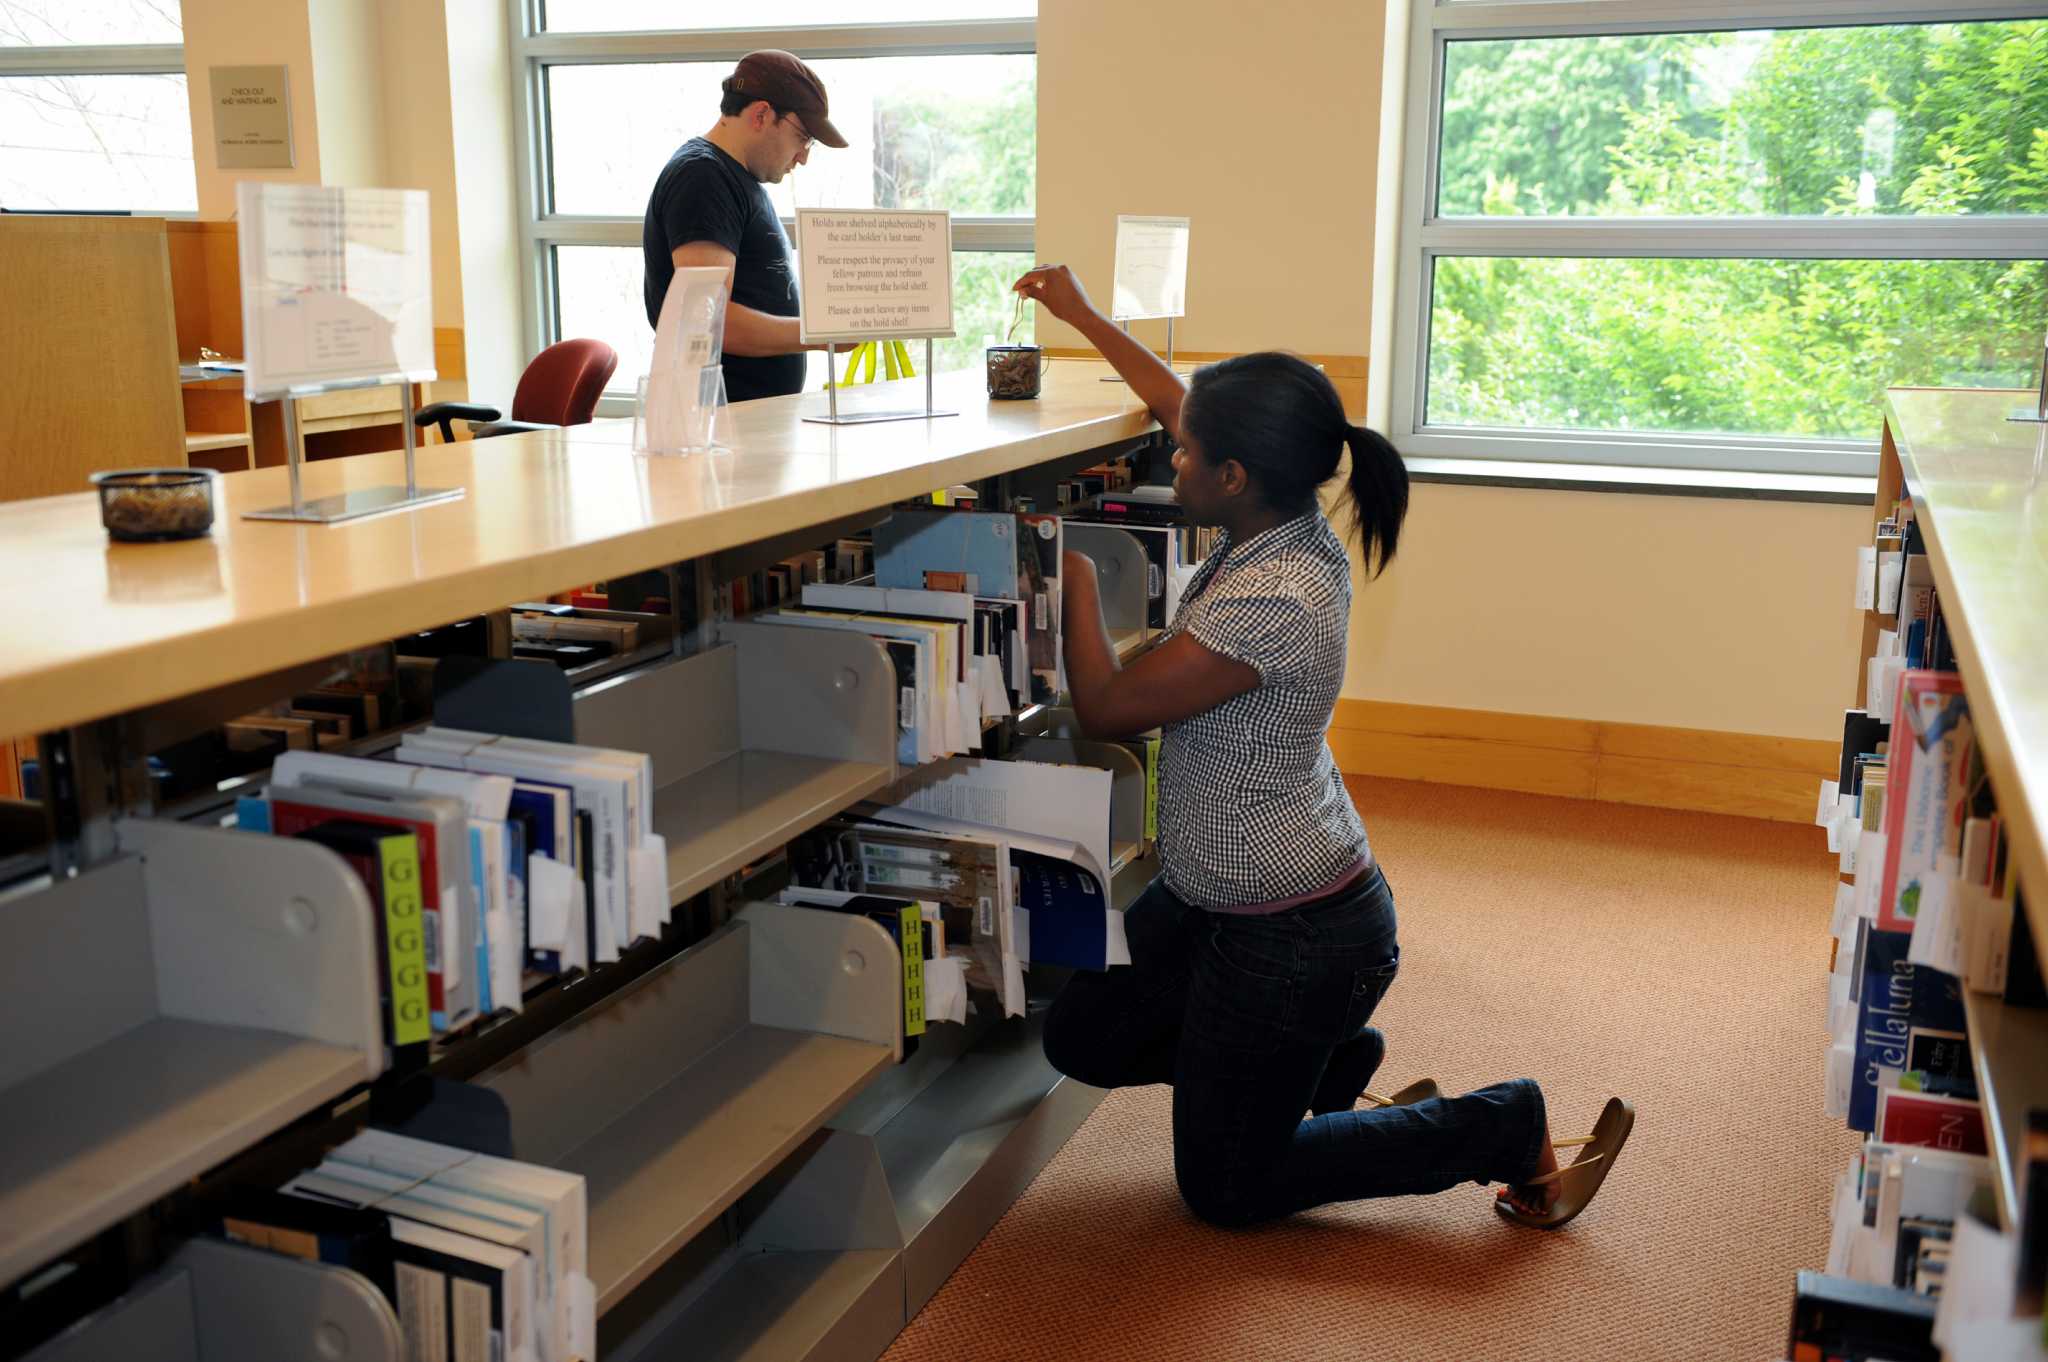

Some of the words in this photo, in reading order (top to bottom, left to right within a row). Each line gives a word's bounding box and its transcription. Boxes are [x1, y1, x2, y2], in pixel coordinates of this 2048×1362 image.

[811, 217, 834, 228] Holds
[836, 220, 848, 228] are
[849, 217, 877, 228] shelved
[878, 217, 927, 231] alphabetically
[928, 218, 937, 231] by
[827, 232, 840, 242] the
[841, 232, 857, 242] card
[858, 231, 888, 242] holder's
[889, 232, 901, 242] last
[817, 255, 841, 265] Please
[842, 256, 869, 267] respect
[870, 256, 881, 265] the
[882, 257, 909, 267] privacy
[910, 255, 918, 265] of
[919, 257, 935, 267] your
[832, 268, 857, 279] fellow
[857, 270, 883, 281] patrons
[885, 269, 898, 278] and
[826, 282, 845, 293] from
[846, 282, 879, 294] browsing
[880, 282, 892, 291] the
[892, 281, 909, 291] hold
[827, 305, 851, 315] Please
[852, 305, 862, 314] do
[864, 305, 875, 313] not
[877, 304, 896, 313] leave
[897, 306, 910, 315] any
[911, 304, 930, 313] items
[861, 319, 873, 328] the
[873, 318, 889, 328] hold
[388, 858, 412, 883] G
[391, 894, 415, 918] G
[905, 920, 917, 935] H
[394, 929, 417, 953] G
[907, 942, 918, 957] H
[397, 964, 420, 988] G
[908, 964, 919, 979] H
[908, 986, 920, 1000] H
[400, 999, 423, 1022] G
[909, 1007, 921, 1023] H
